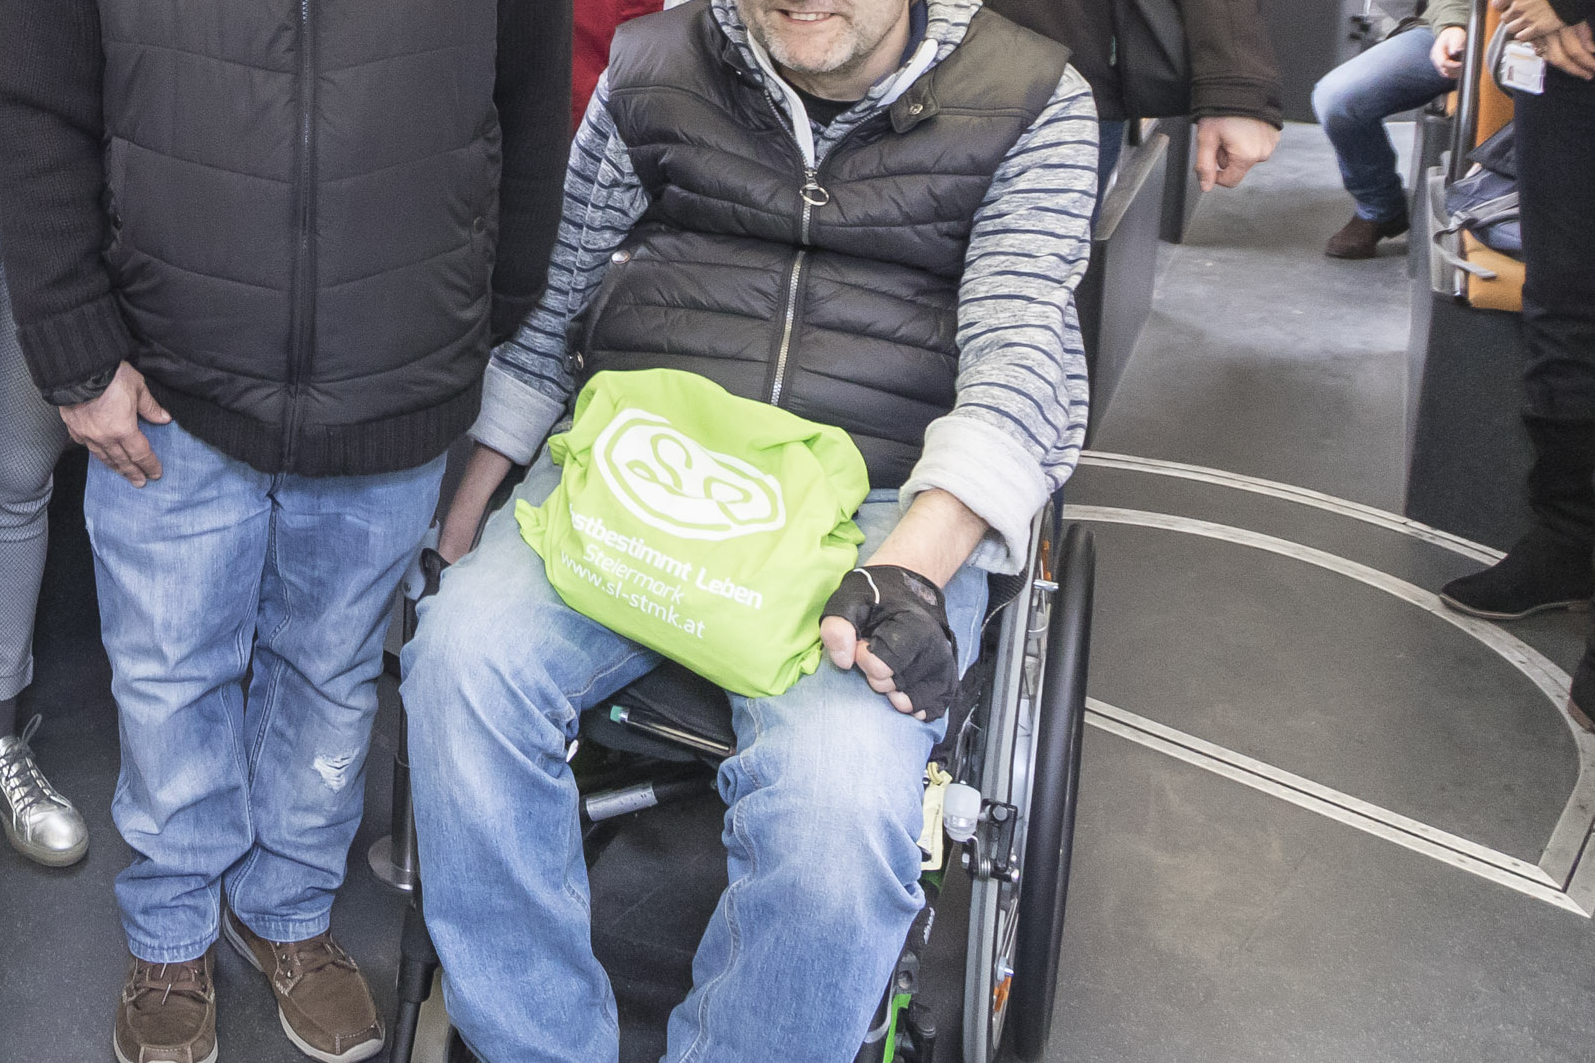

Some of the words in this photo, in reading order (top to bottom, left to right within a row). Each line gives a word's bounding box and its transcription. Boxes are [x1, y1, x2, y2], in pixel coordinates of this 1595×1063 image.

[560, 549, 706, 639] www.sl-stmk.at
[583, 543, 685, 605] Steiermark
[695, 567, 763, 610] Leben
